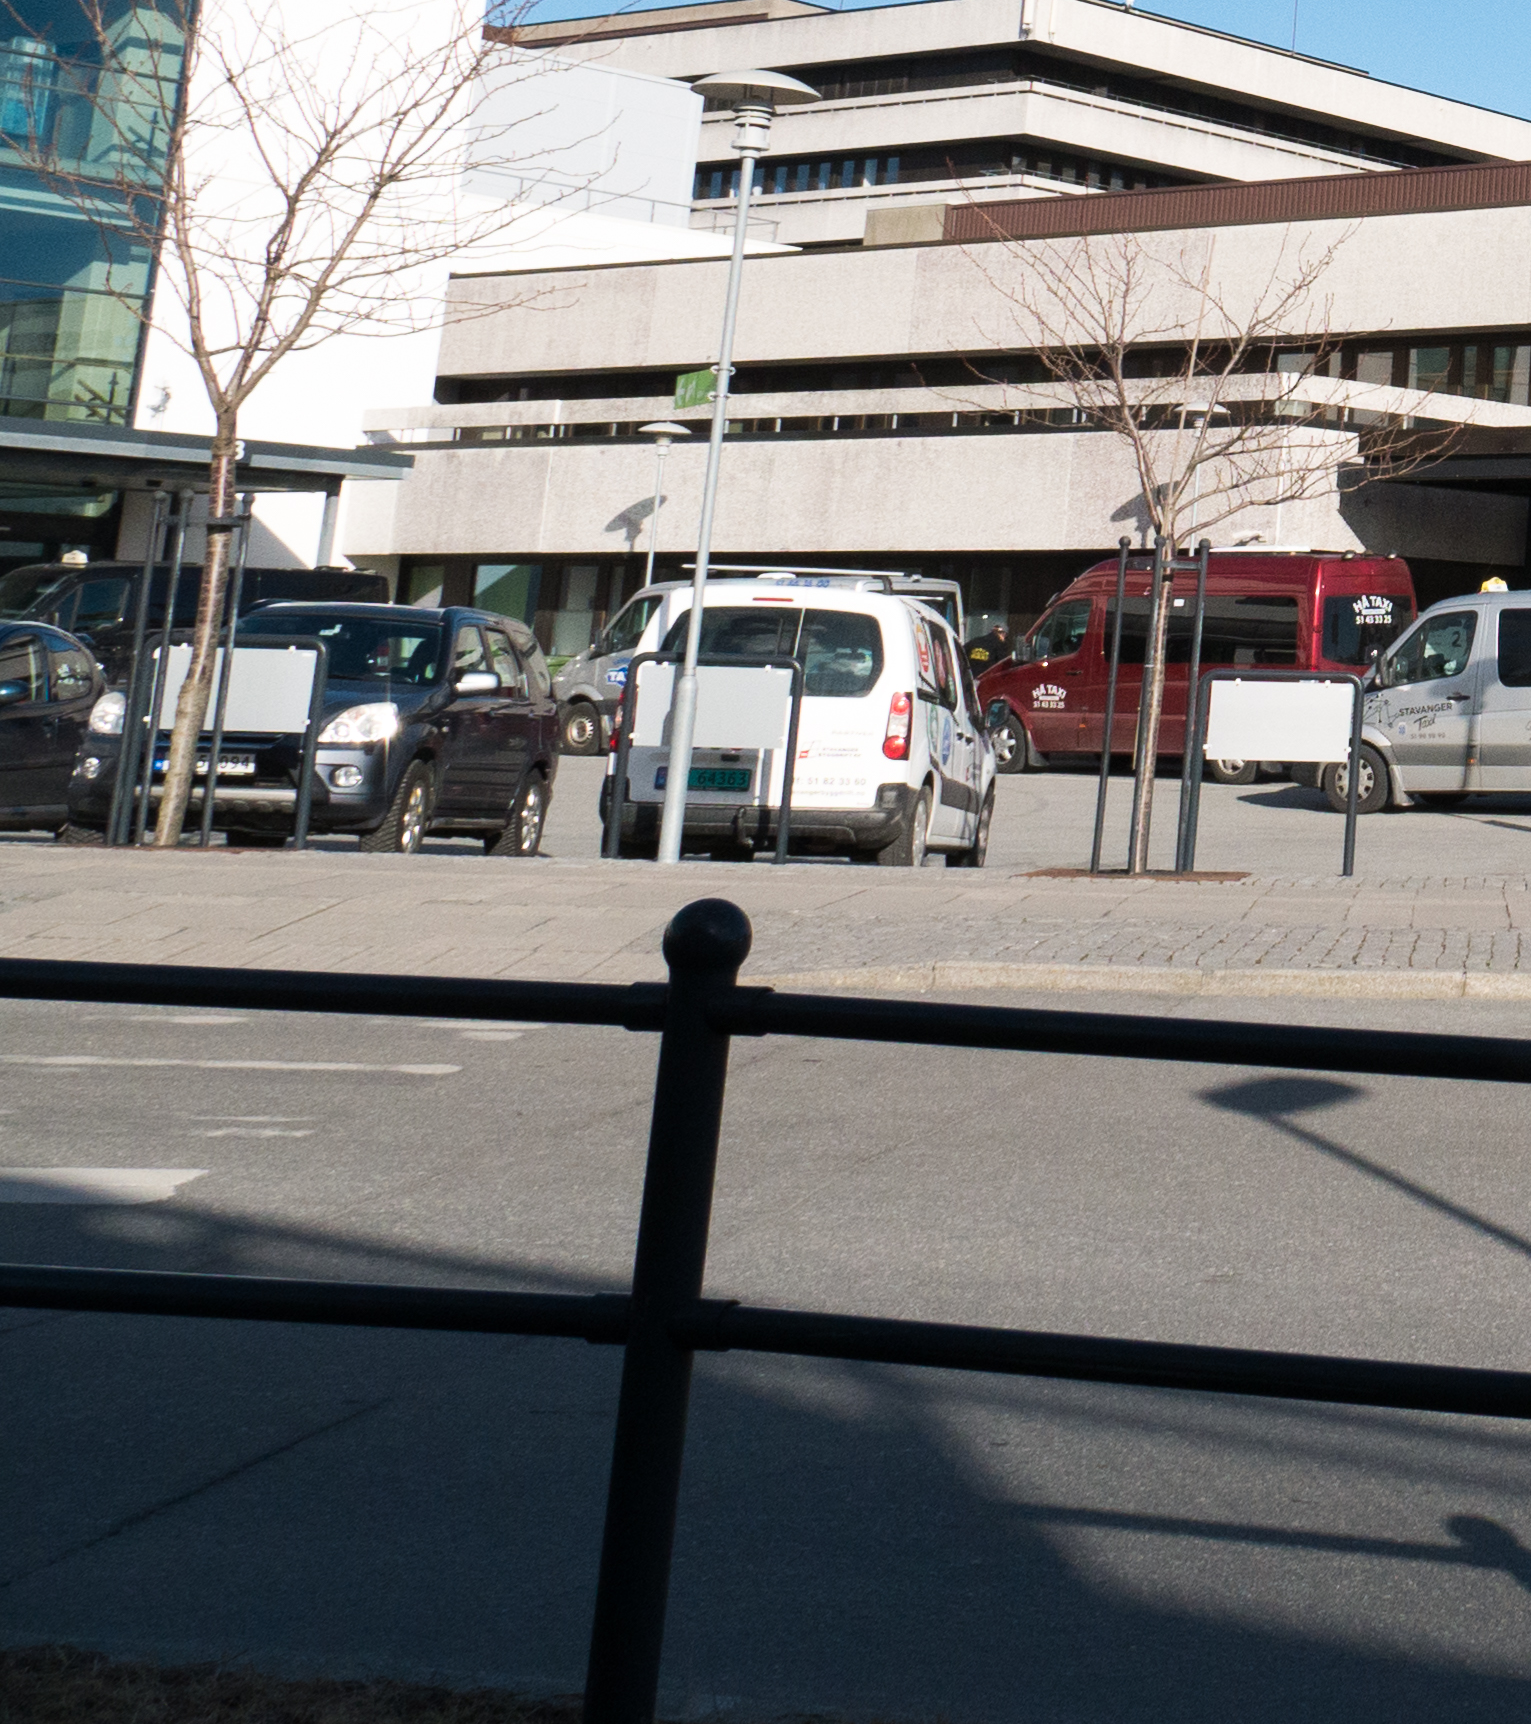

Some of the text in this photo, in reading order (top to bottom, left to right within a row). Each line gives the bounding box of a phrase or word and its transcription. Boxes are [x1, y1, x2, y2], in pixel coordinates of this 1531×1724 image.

[1352, 594, 1394, 614] HÅ TAXI
[1046, 684, 1067, 700] TAXI
[1399, 702, 1453, 717] STAVANGER
[1413, 713, 1437, 732] Taxi
